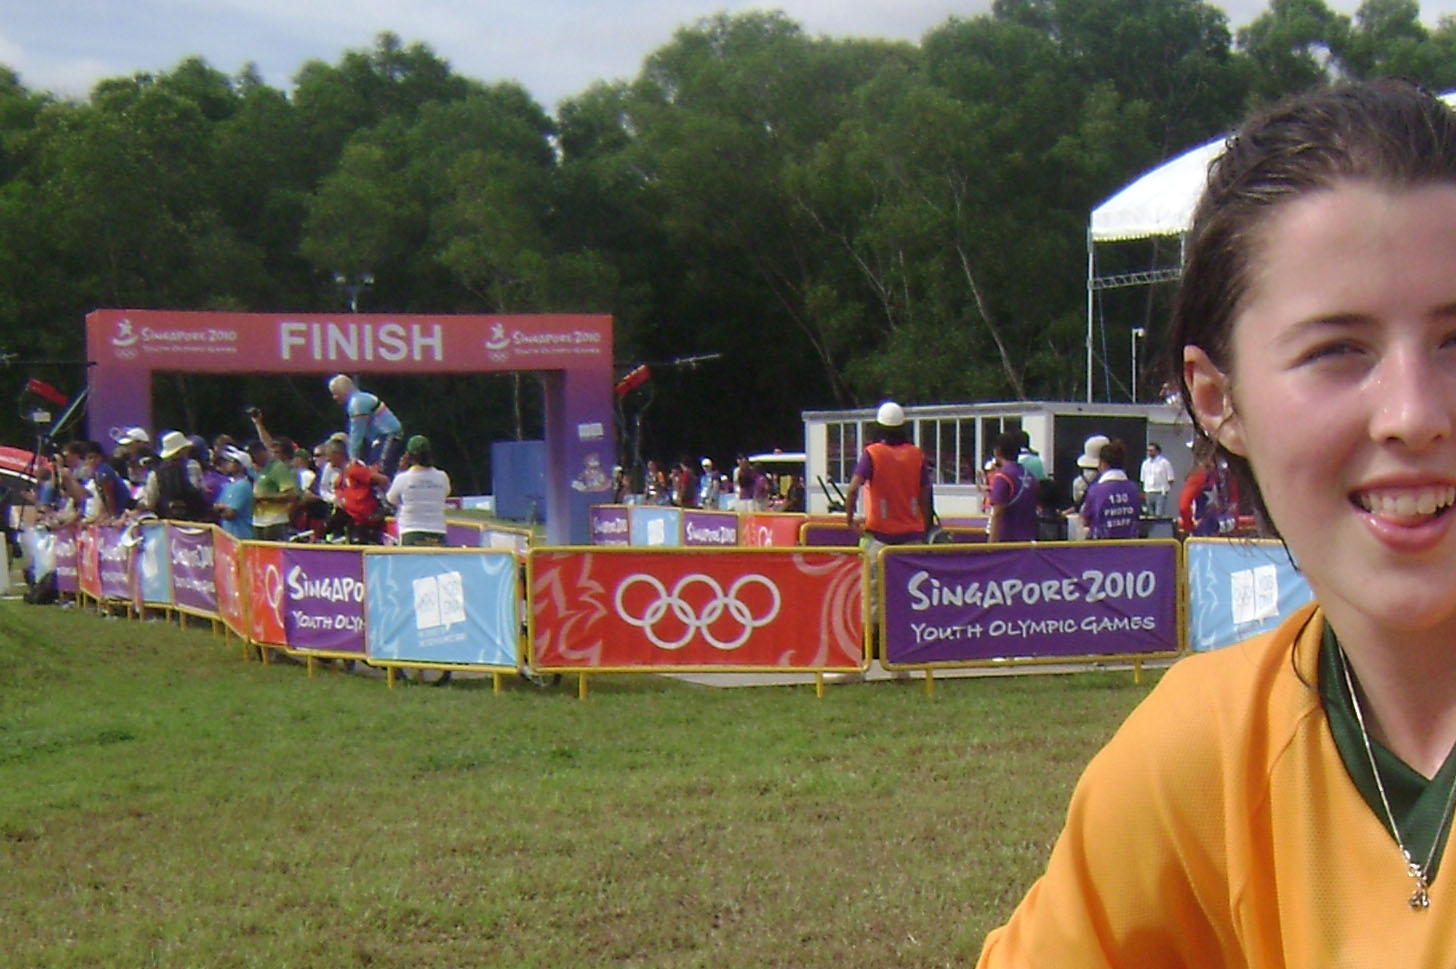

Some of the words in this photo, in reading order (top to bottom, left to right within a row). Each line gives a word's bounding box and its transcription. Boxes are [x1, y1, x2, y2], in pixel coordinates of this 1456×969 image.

[208, 329, 237, 342] 2010
[278, 321, 443, 361] FINISH
[573, 331, 601, 343] 2010
[1104, 506, 1134, 516] PHOTO
[1082, 570, 1156, 603] 2010
[292, 610, 333, 630] YOUTH
[911, 622, 983, 643] YOUTH
[988, 617, 1078, 638] OLYMPIC
[1080, 615, 1156, 634] GAMES
